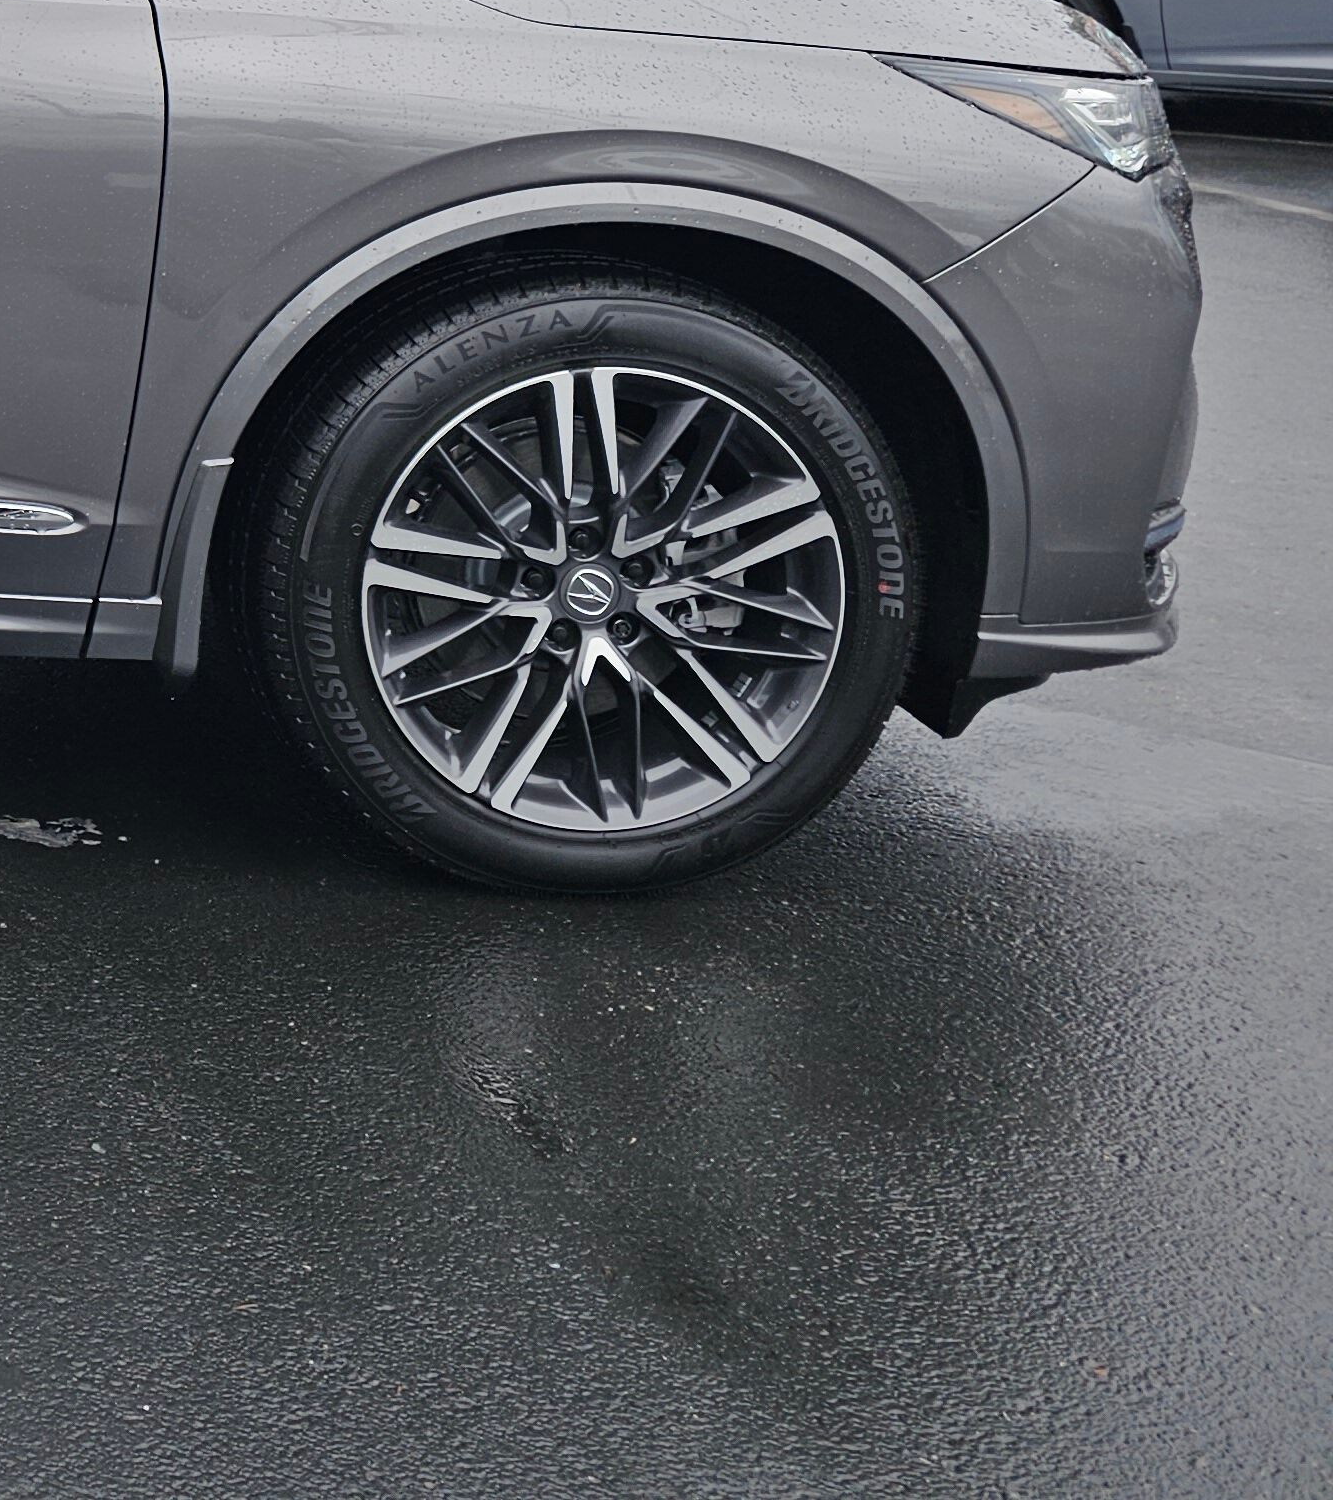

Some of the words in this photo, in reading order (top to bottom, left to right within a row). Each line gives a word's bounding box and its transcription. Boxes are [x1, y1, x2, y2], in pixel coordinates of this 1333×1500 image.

[413, 309, 572, 393] ALENZA
[774, 366, 908, 619] BRIDGESTONE
[302, 578, 440, 823] BRIDGESTONE
